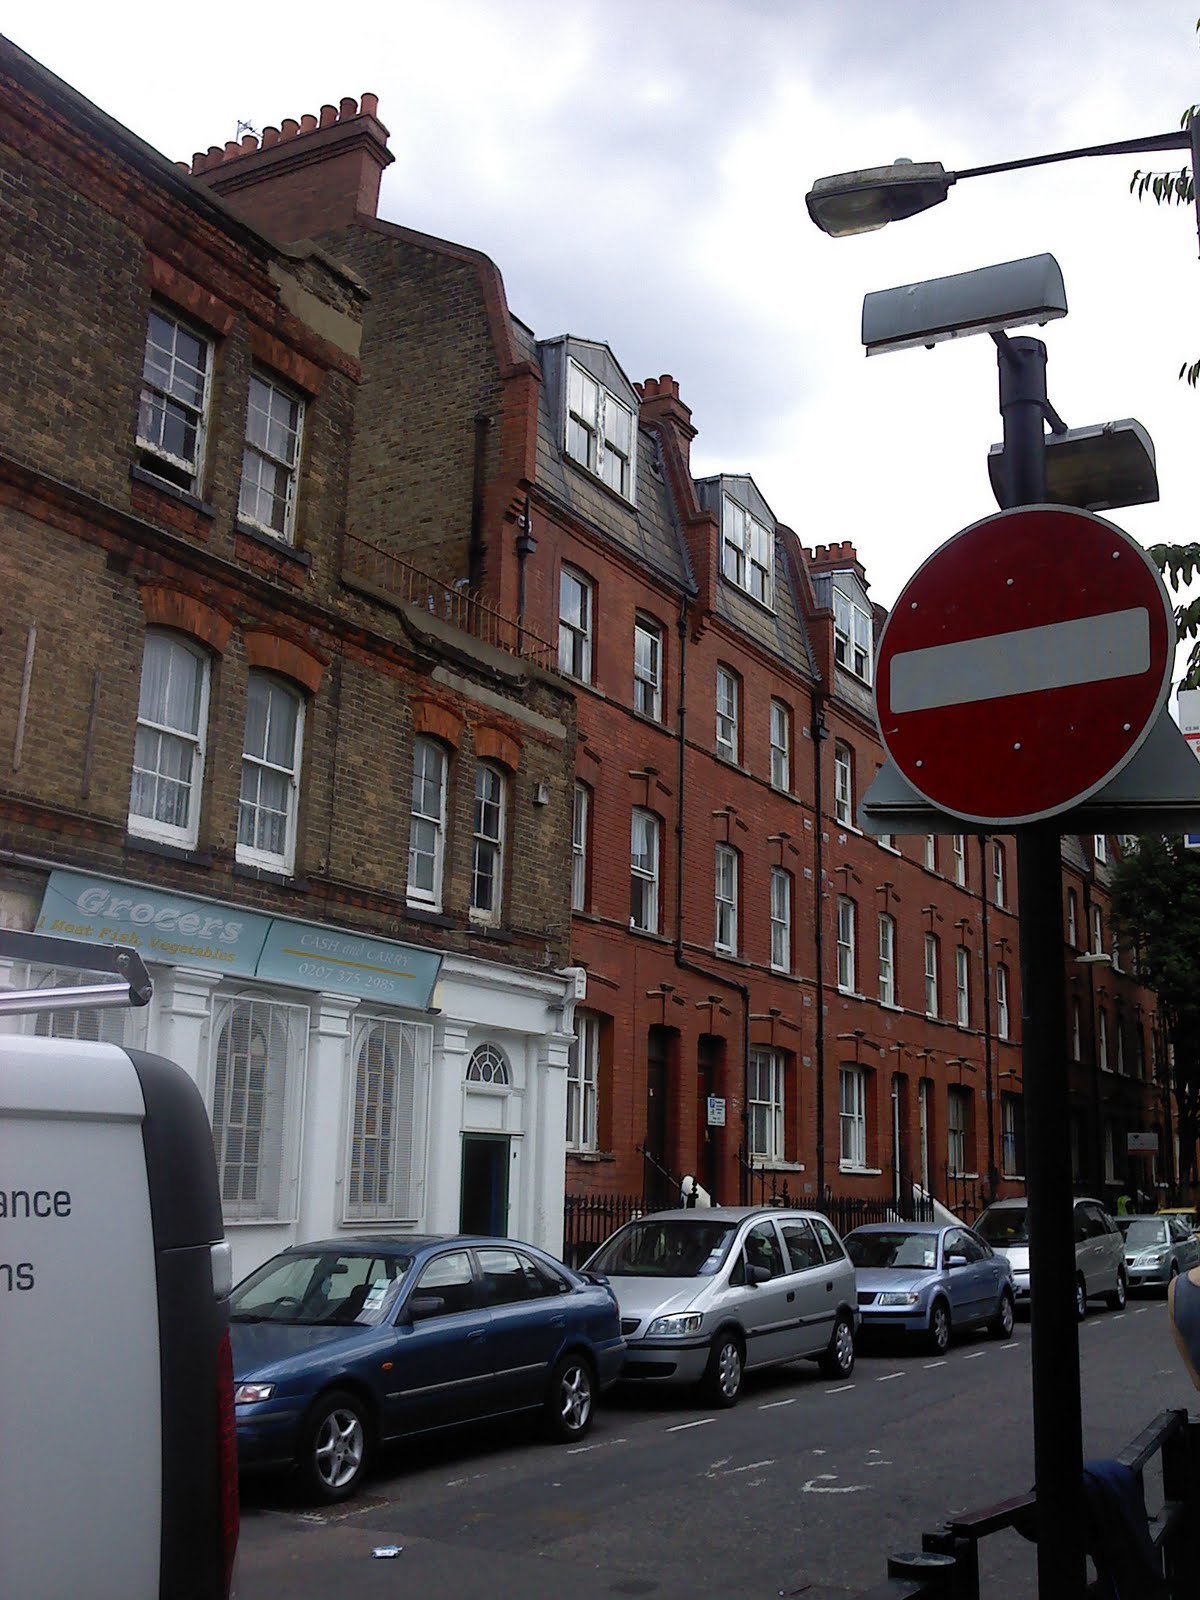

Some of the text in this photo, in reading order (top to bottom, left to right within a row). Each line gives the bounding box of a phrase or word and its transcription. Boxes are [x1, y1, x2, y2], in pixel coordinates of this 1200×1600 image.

[77, 887, 243, 943] Grocers
[50, 919, 92, 937] Meat
[149, 937, 235, 962] Vegetables
[300, 934, 411, 967] CASH and CARRY
[298, 962, 333, 979] 0207
[335, 968, 360, 983] 375
